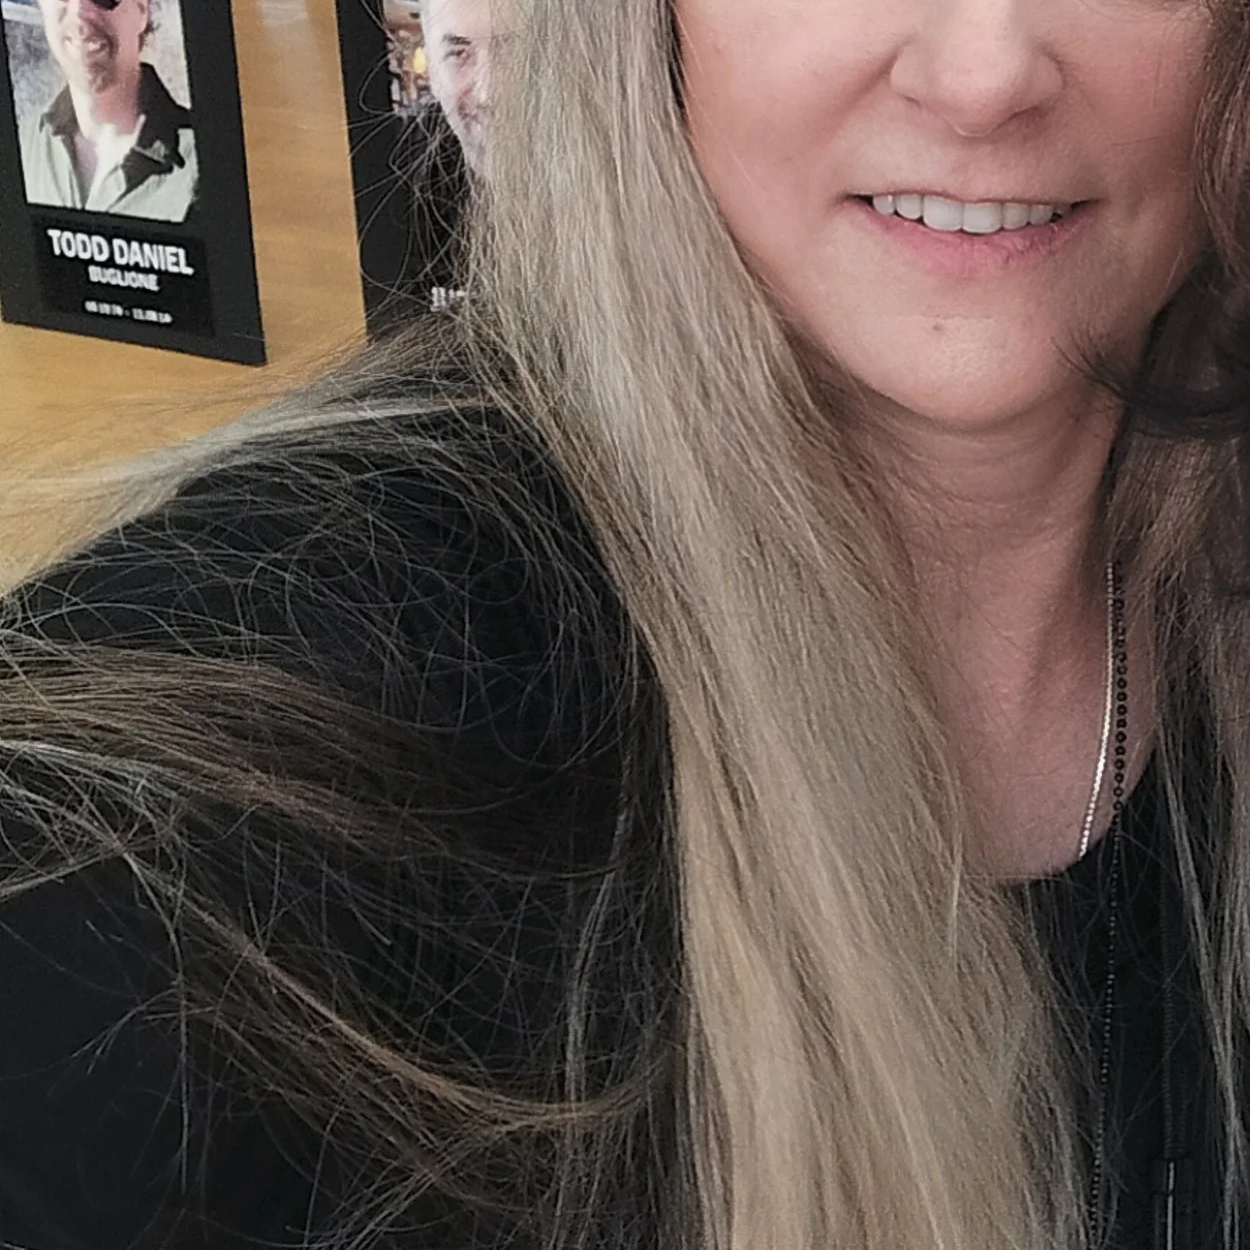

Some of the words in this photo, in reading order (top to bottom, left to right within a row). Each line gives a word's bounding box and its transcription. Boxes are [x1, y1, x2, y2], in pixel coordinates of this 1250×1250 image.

[46, 228, 110, 263] TODD
[111, 237, 196, 276] DANIEL
[87, 264, 161, 292] BUGLIONE
